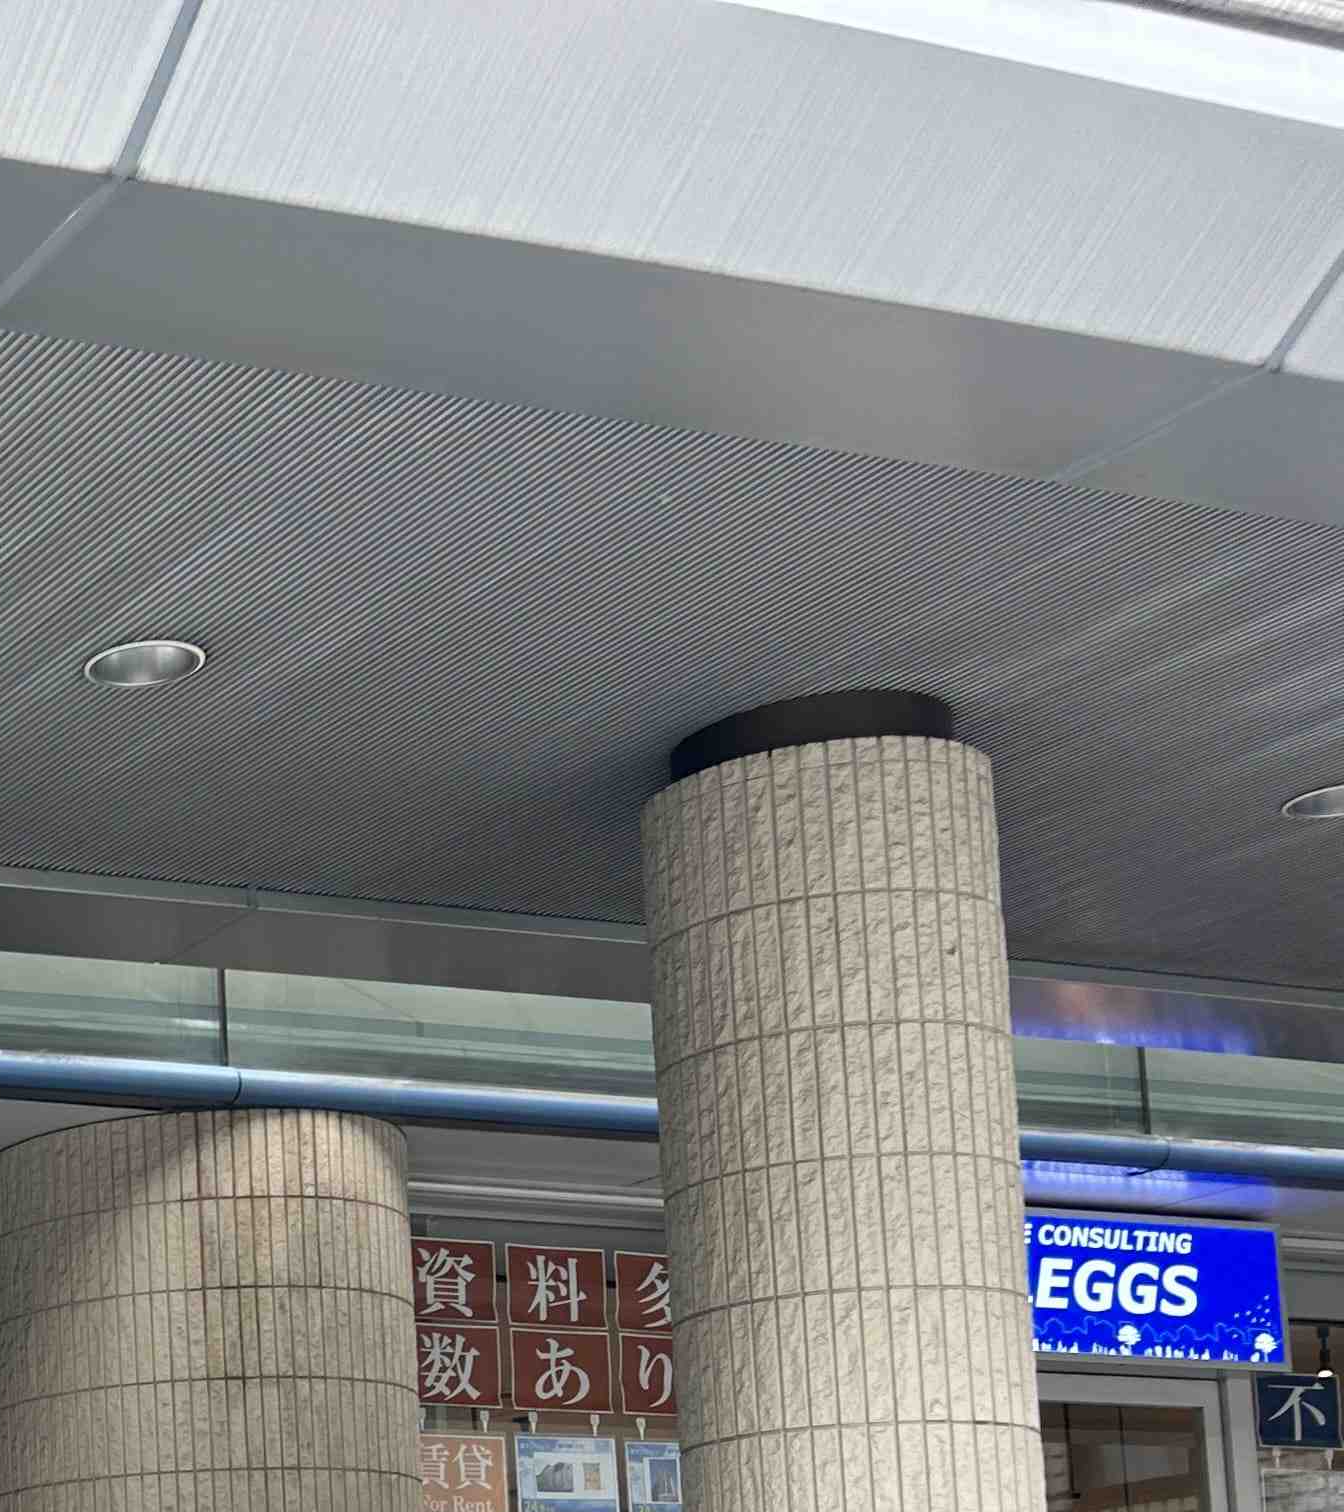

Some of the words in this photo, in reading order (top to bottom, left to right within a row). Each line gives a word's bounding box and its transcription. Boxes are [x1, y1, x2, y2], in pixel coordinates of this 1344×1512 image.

[1037, 1223, 1193, 1255] CONSULTING
[1265, 1382, 1327, 1441] 不
[453, 1497, 495, 1512] Rent
